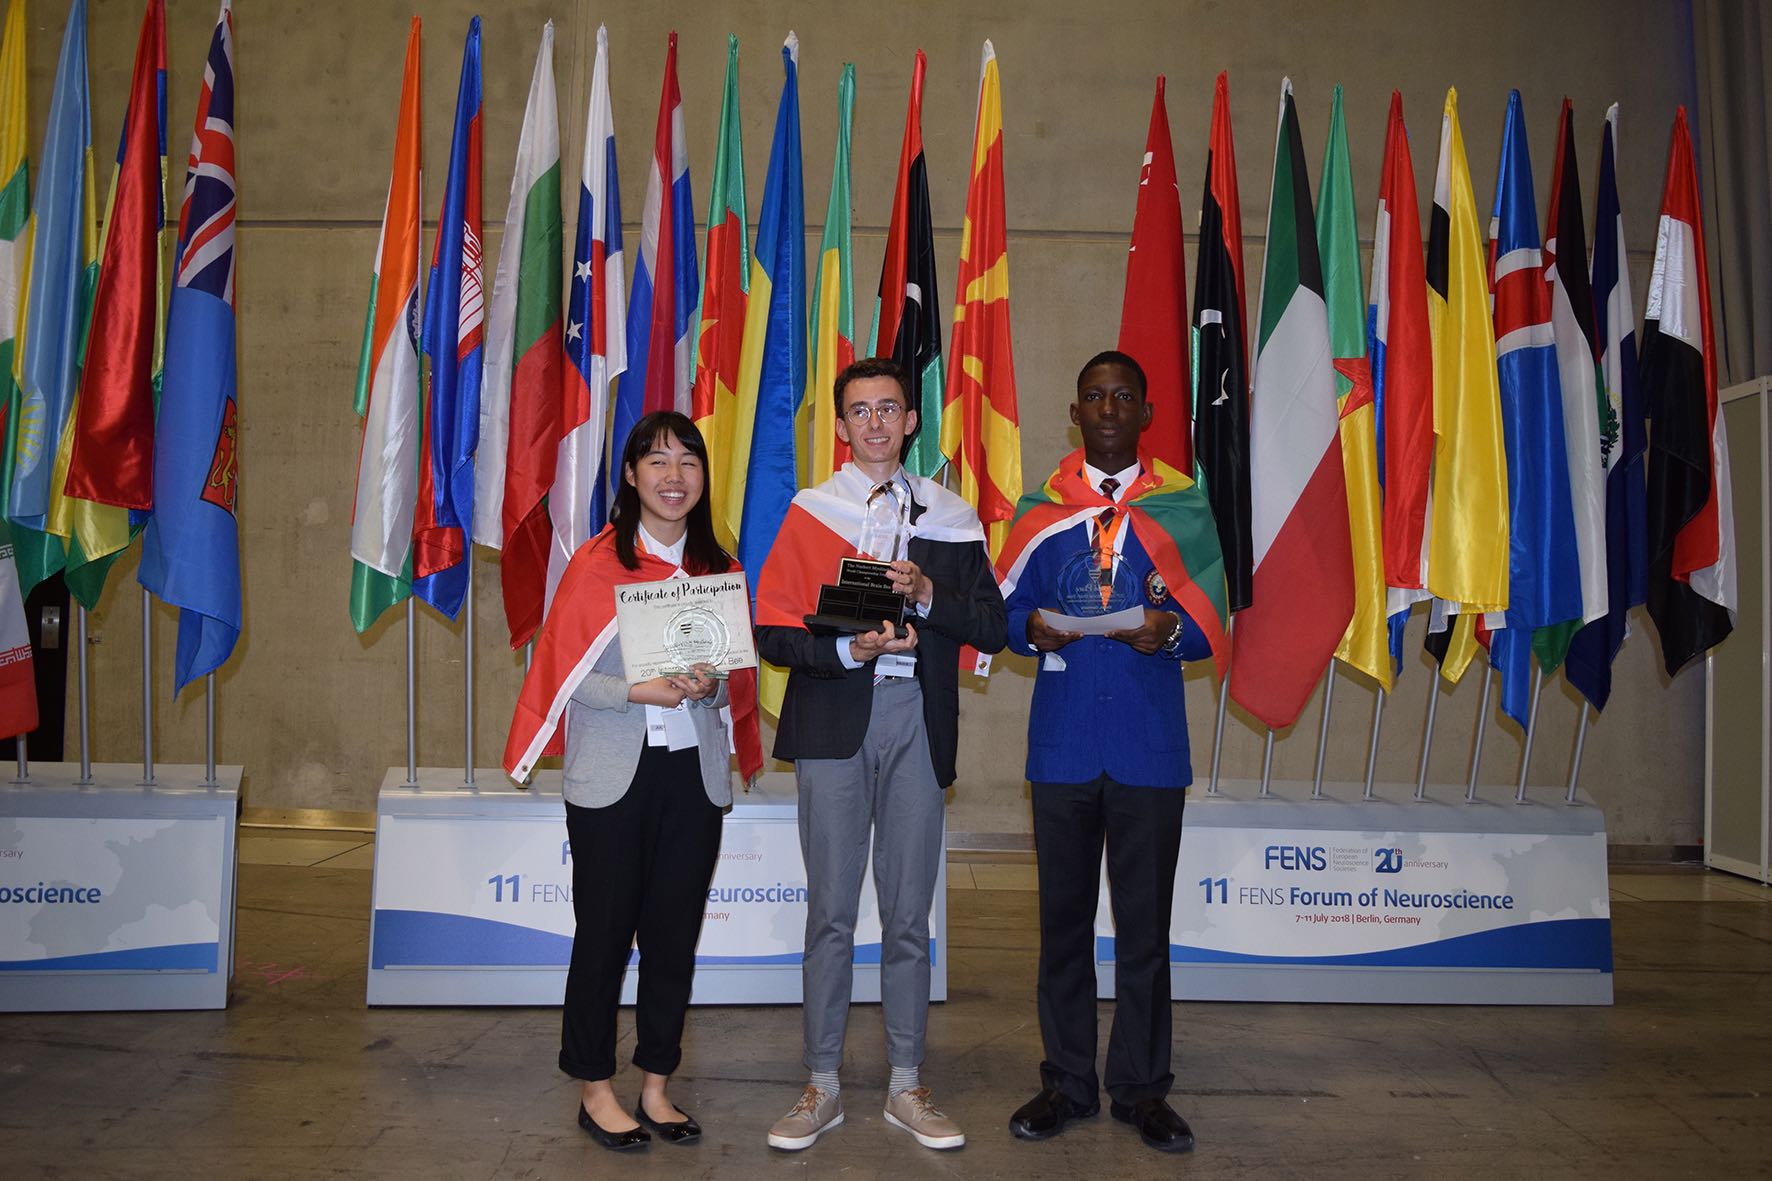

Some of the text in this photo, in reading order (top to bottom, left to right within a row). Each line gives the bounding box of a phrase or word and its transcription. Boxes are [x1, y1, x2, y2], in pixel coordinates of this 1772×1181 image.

[619, 588, 668, 605] Certificate
[671, 586, 680, 601] of
[682, 581, 742, 597] Participation
[719, 852, 762, 862] nniversary
[1264, 845, 1327, 871] FENS
[1403, 859, 1448, 870] anniversary
[0, 881, 101, 904] oscience
[532, 884, 574, 903] FEN
[706, 882, 808, 903] euroscien
[1239, 887, 1285, 905] FENS
[1290, 887, 1353, 907] Forum
[1358, 888, 1378, 907] of
[1384, 888, 1514, 910] Neuroscience
[703, 912, 730, 921] many
[1295, 913, 1421, 925] 7-11 July 2018 Berlin, Germany
